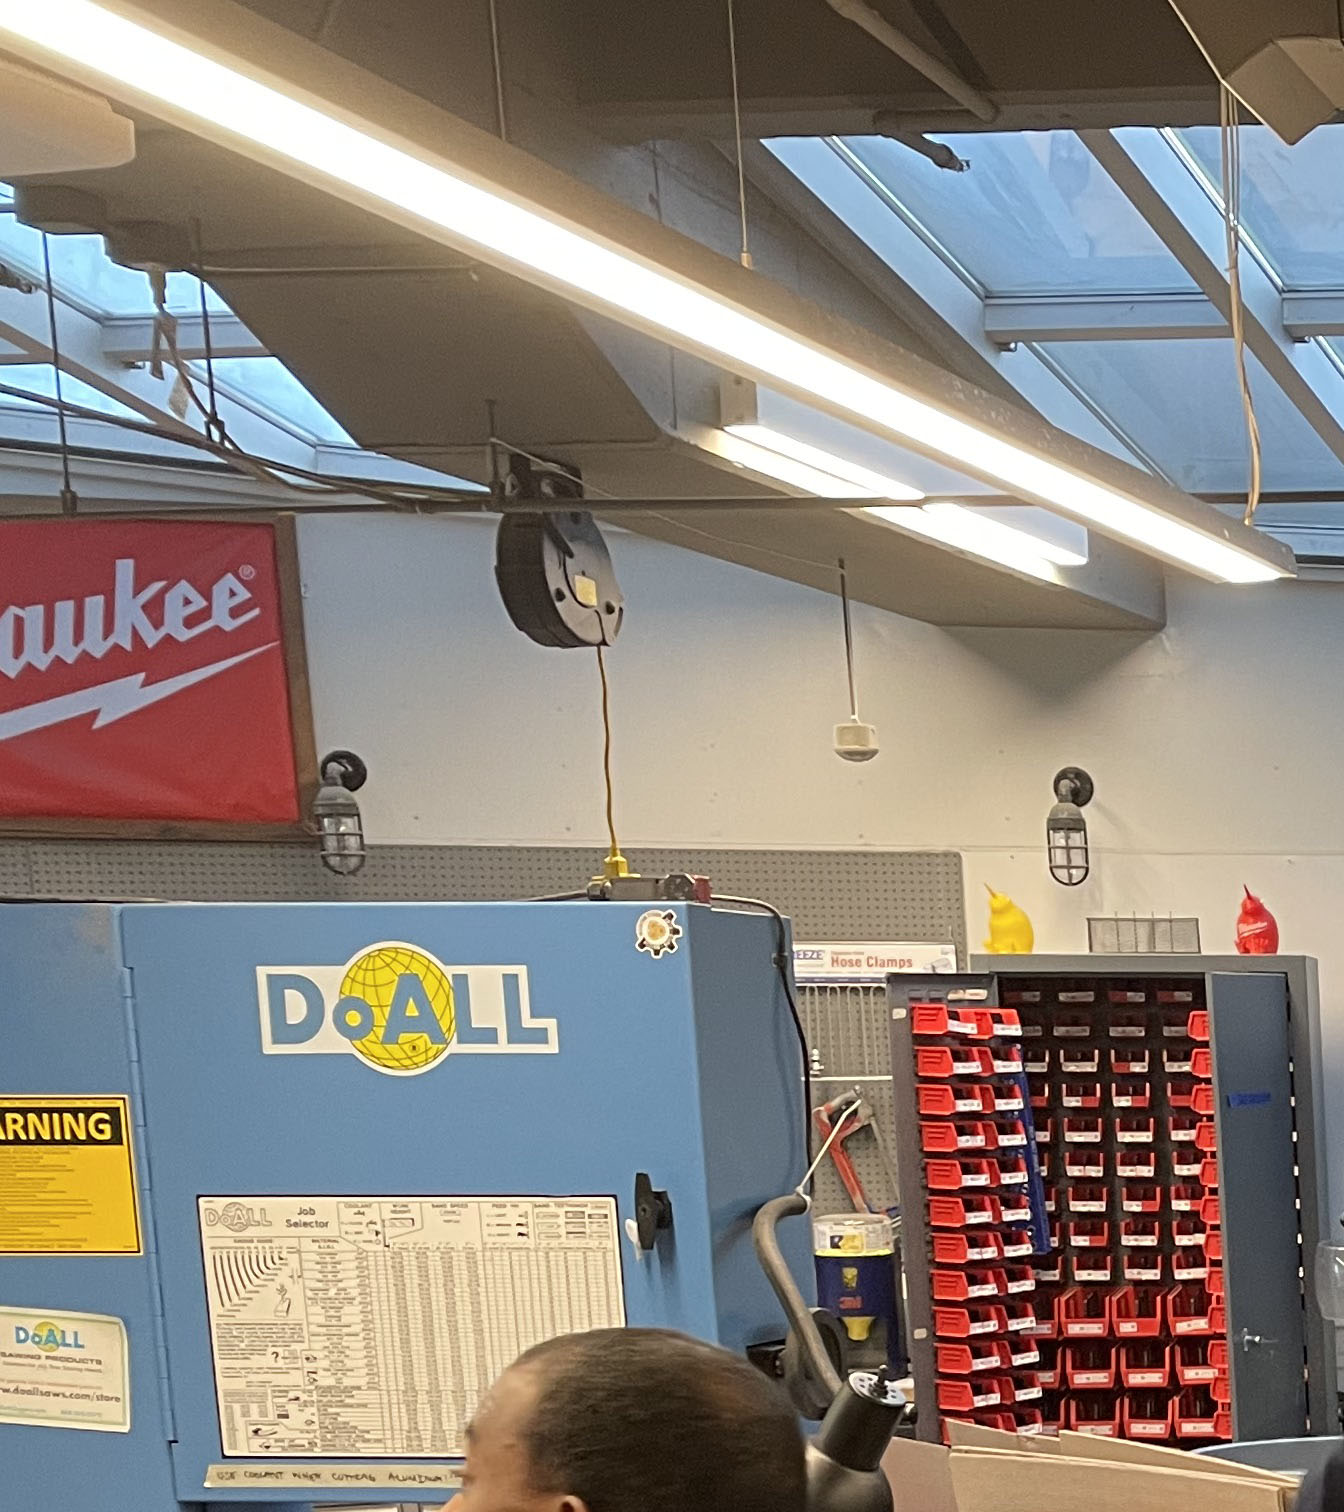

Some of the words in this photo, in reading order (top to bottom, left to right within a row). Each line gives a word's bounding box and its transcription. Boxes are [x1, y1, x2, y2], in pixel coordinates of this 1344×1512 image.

[831, 955, 862, 968] Hose
[866, 955, 913, 969] Clamps
[0, 1112, 112, 1141] RNING
[297, 1206, 316, 1216] Job
[285, 1218, 330, 1229] Selector
